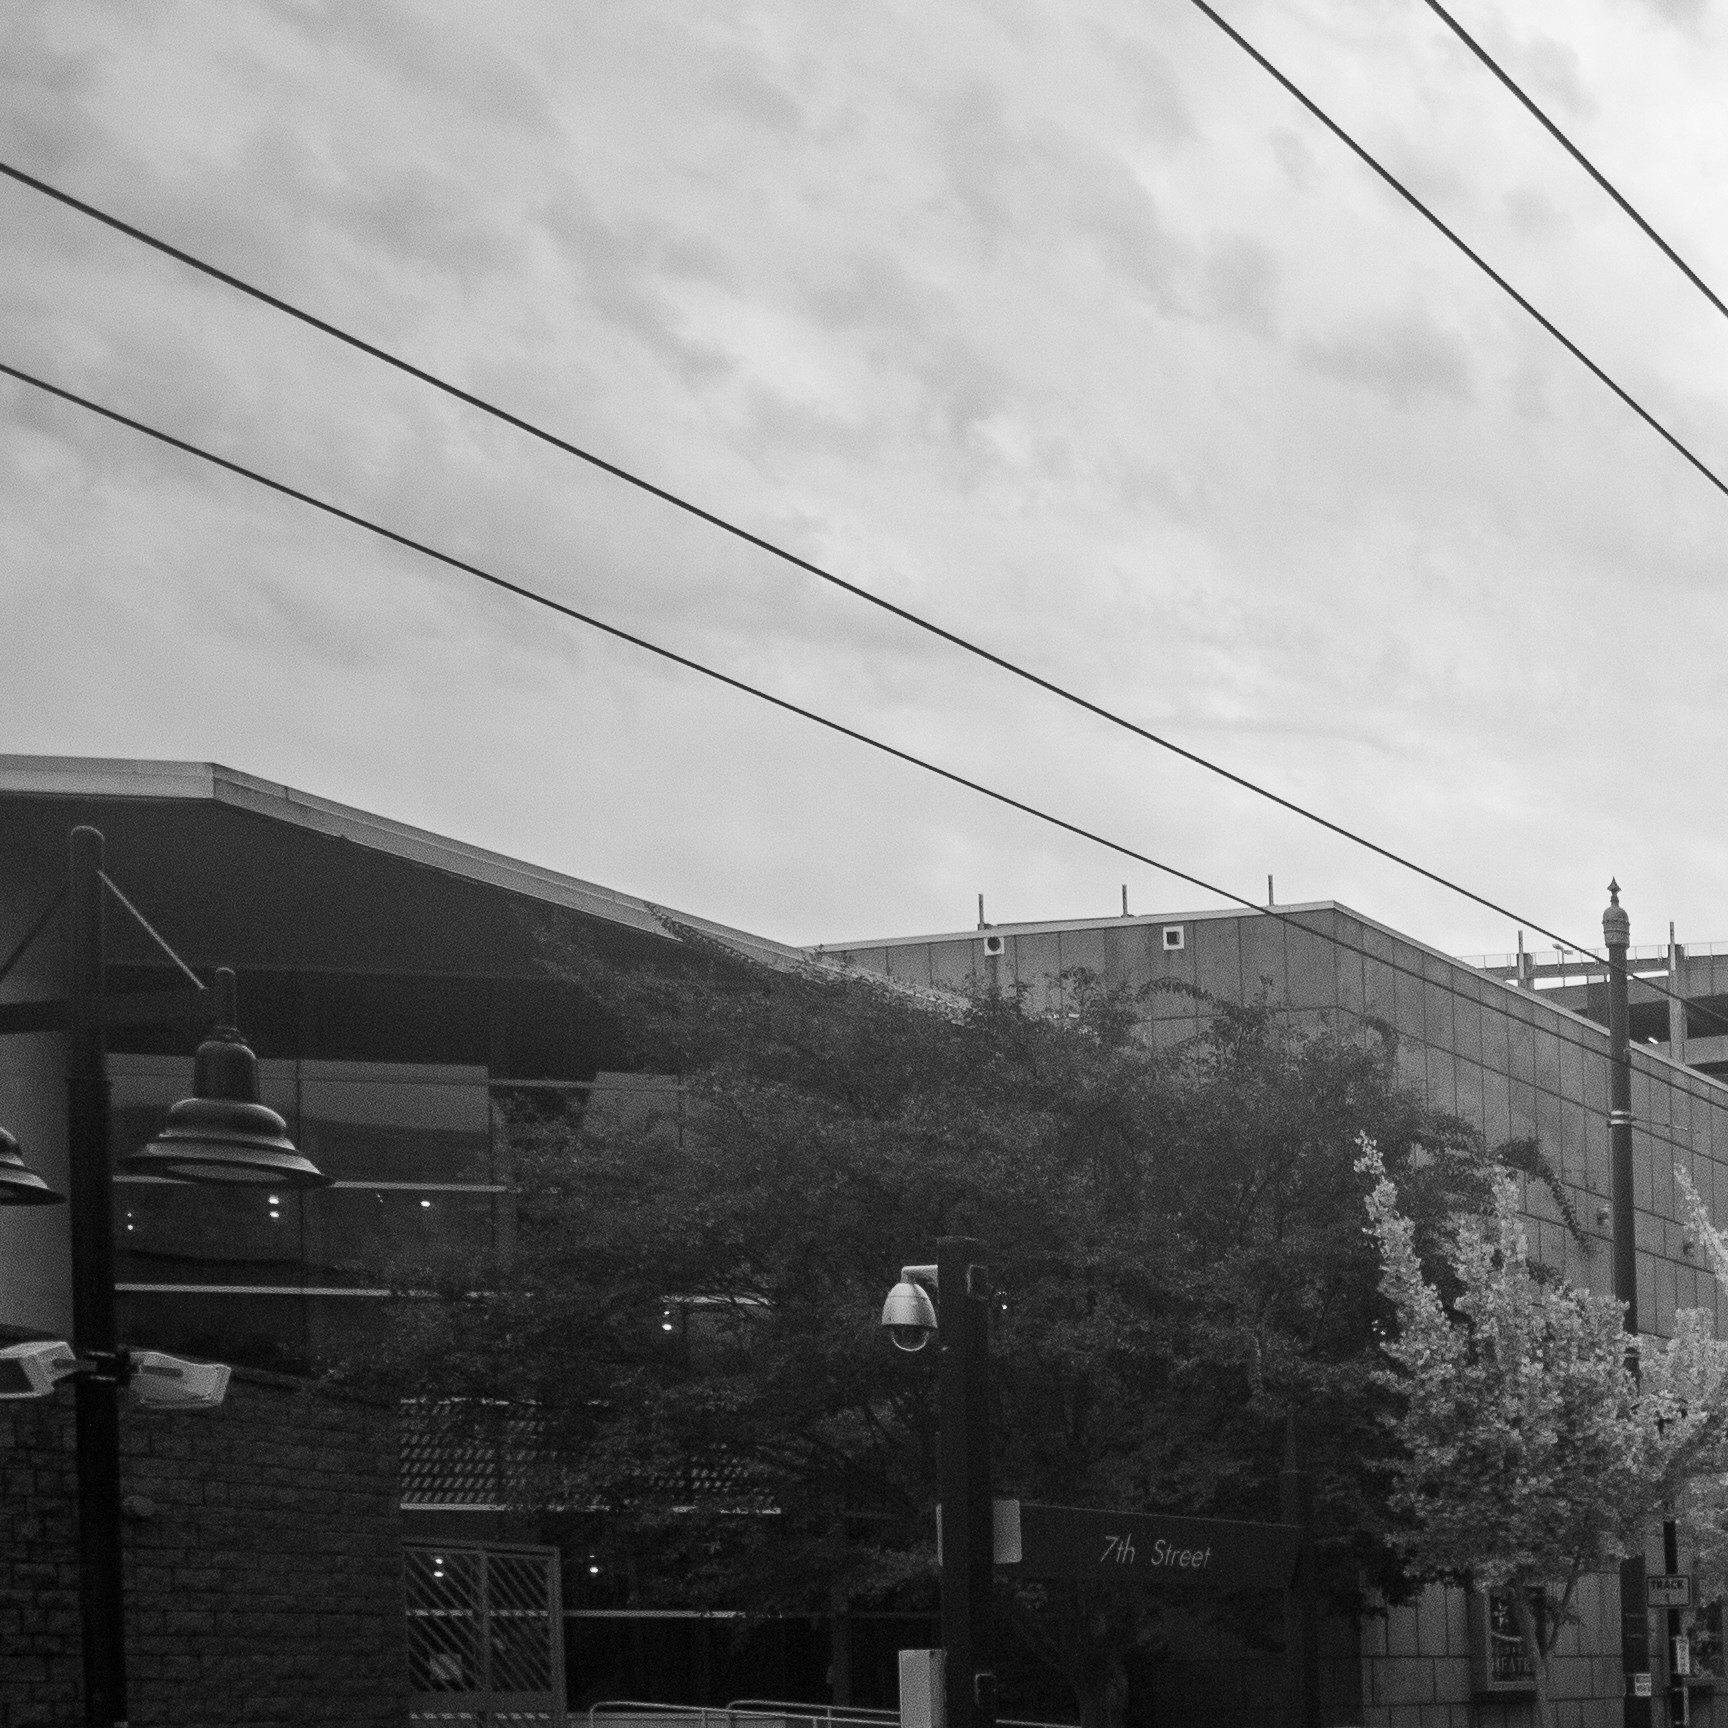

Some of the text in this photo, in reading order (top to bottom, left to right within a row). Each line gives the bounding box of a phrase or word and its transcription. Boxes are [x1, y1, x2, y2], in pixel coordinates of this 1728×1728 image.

[1099, 1532, 1212, 1569] 7th Street
[1651, 1580, 1684, 1590] TRACK
